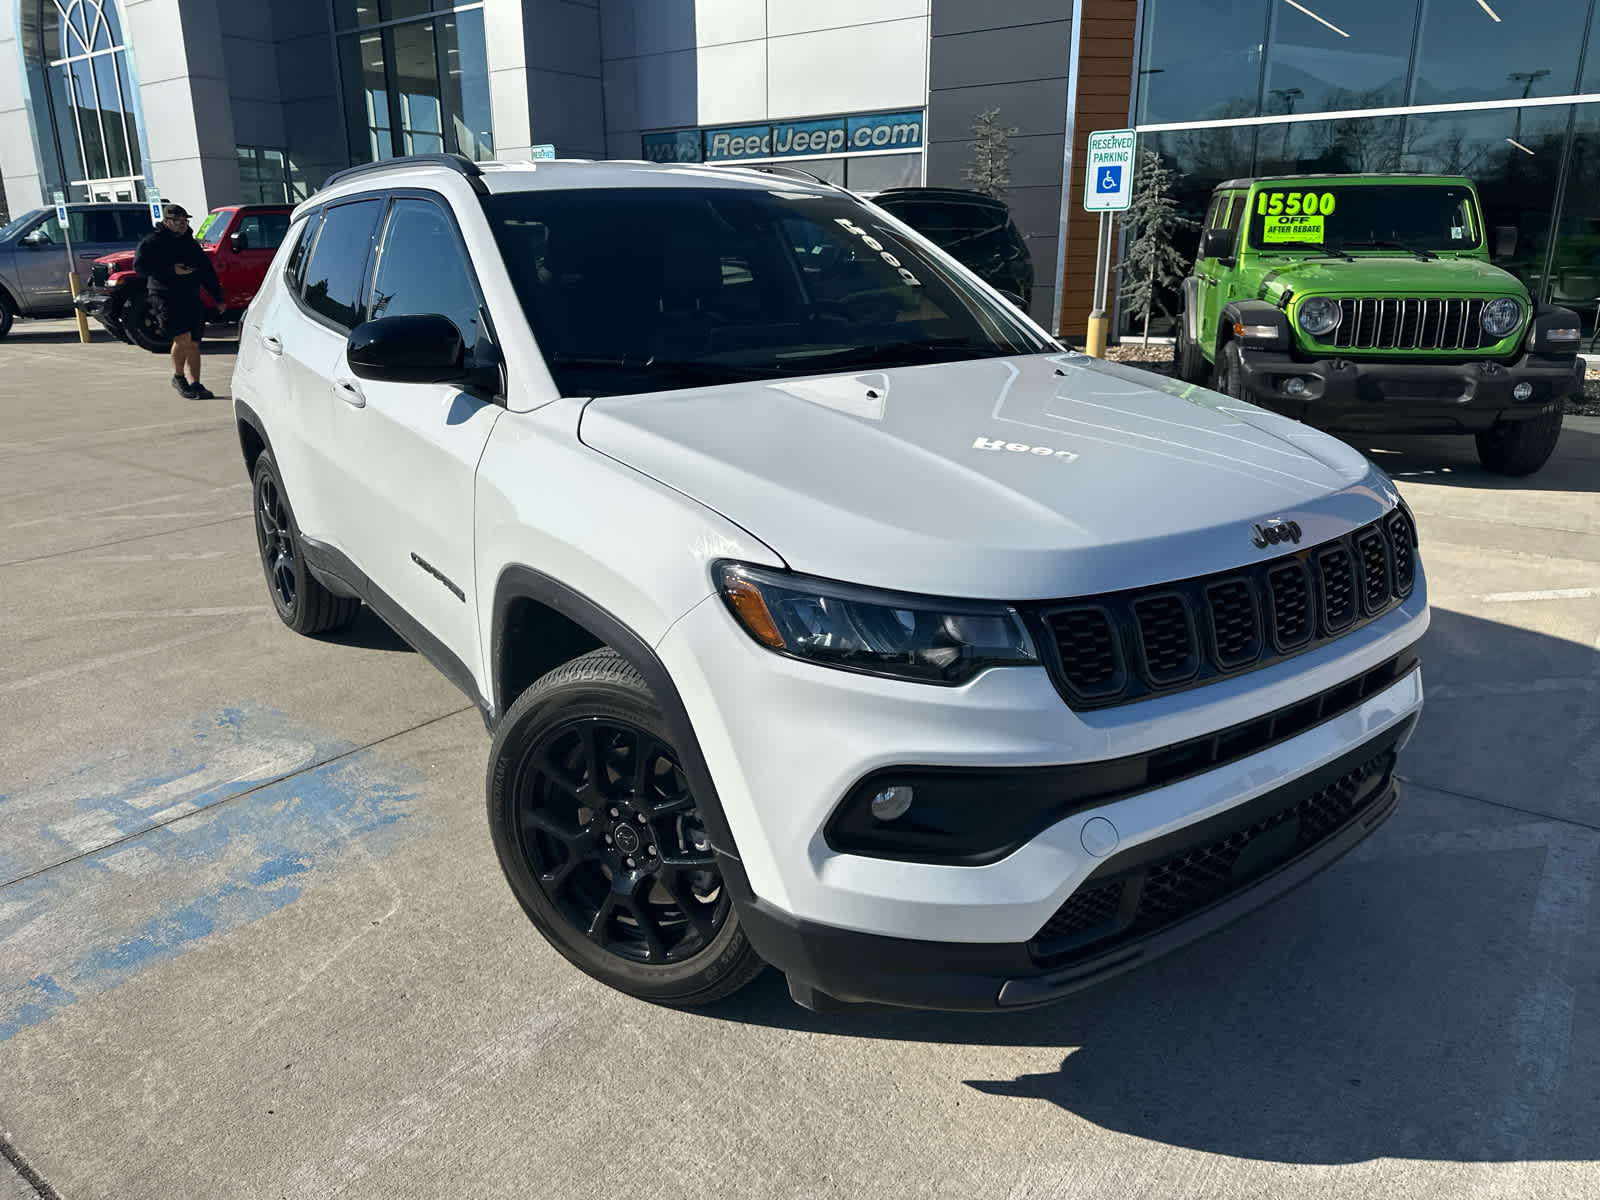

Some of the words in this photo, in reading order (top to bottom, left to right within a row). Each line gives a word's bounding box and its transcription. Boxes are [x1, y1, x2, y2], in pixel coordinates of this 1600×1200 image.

[1092, 137, 1132, 150] RESERVED
[1094, 151, 1129, 163] PARKING
[1257, 192, 1335, 215] 15500
[1278, 216, 1310, 224] OFF
[1267, 225, 1291, 233] AFTER
[1292, 225, 1321, 233] REBATE
[1251, 520, 1302, 549] Jeep
